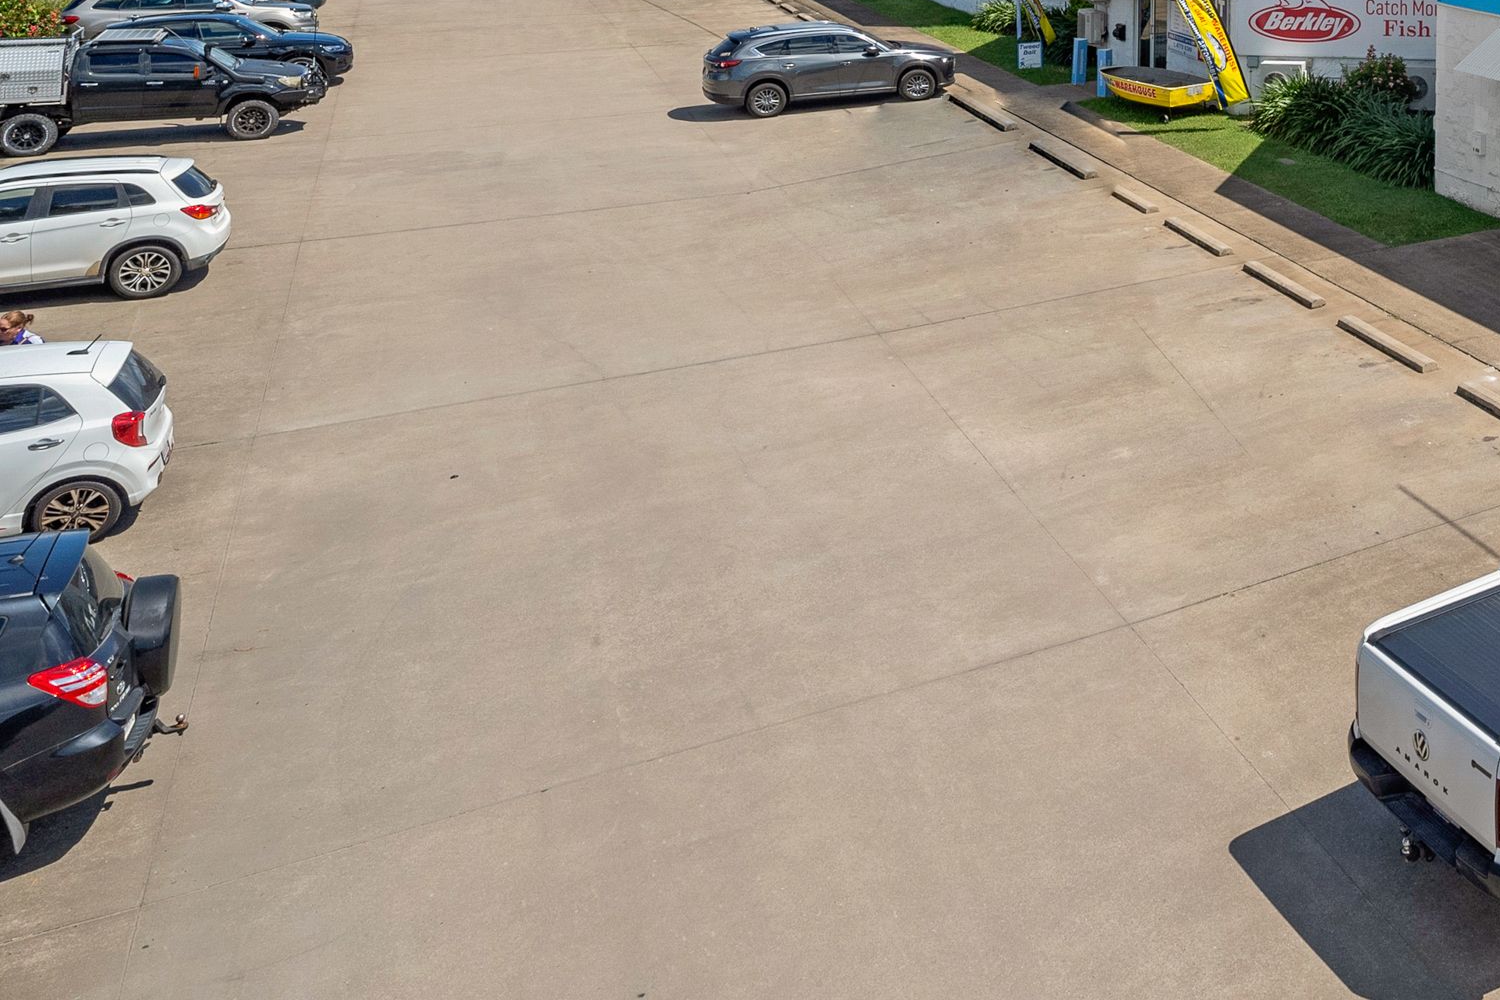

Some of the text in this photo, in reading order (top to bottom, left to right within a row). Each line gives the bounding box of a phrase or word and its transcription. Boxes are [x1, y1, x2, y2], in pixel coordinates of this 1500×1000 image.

[1264, 11, 1347, 37] Berkley
[1383, 19, 1431, 37] Fish
[1114, 80, 1157, 98] WAREHOUSE
[1395, 746, 1448, 796] AMAROK
